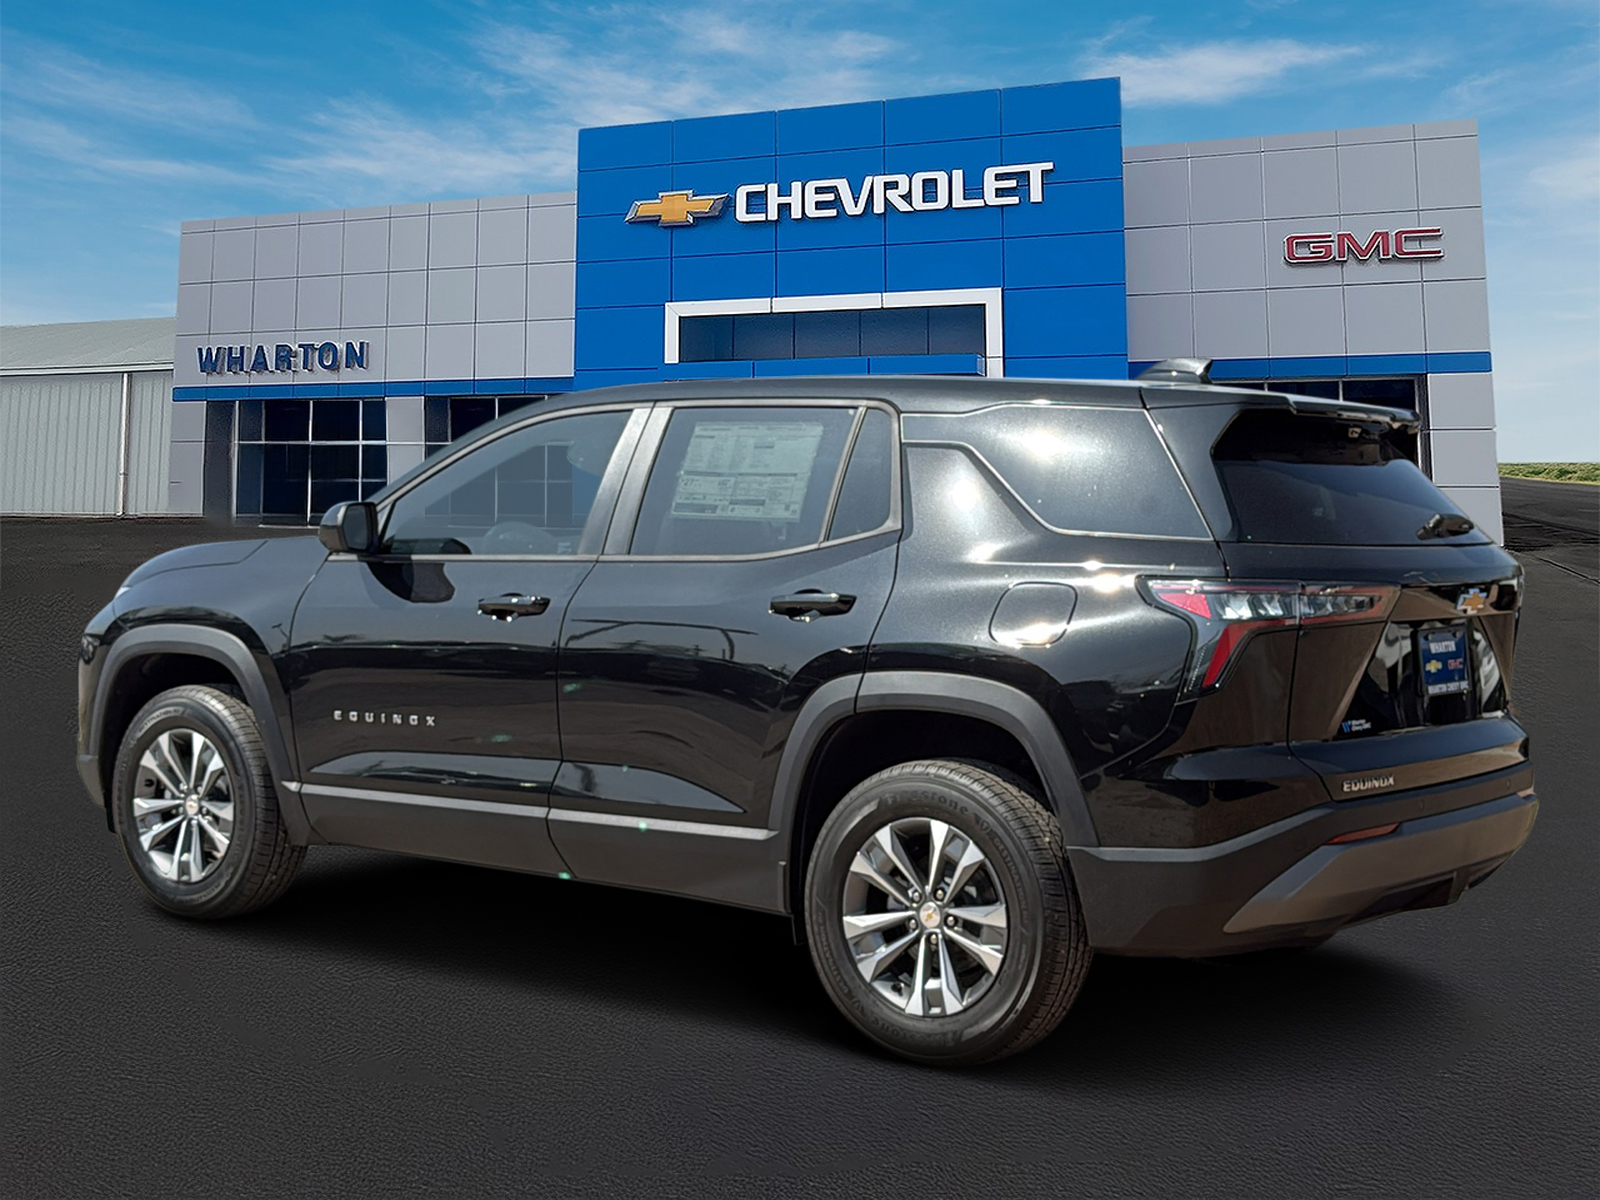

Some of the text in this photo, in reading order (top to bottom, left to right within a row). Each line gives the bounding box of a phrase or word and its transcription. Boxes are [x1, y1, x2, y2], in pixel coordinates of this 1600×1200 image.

[734, 161, 1054, 223] CHEVROLET
[1284, 226, 1445, 265] GMC
[197, 341, 369, 374] WHARTON
[333, 709, 436, 728] EQUINOX
[1342, 774, 1395, 792] EQUINOX
